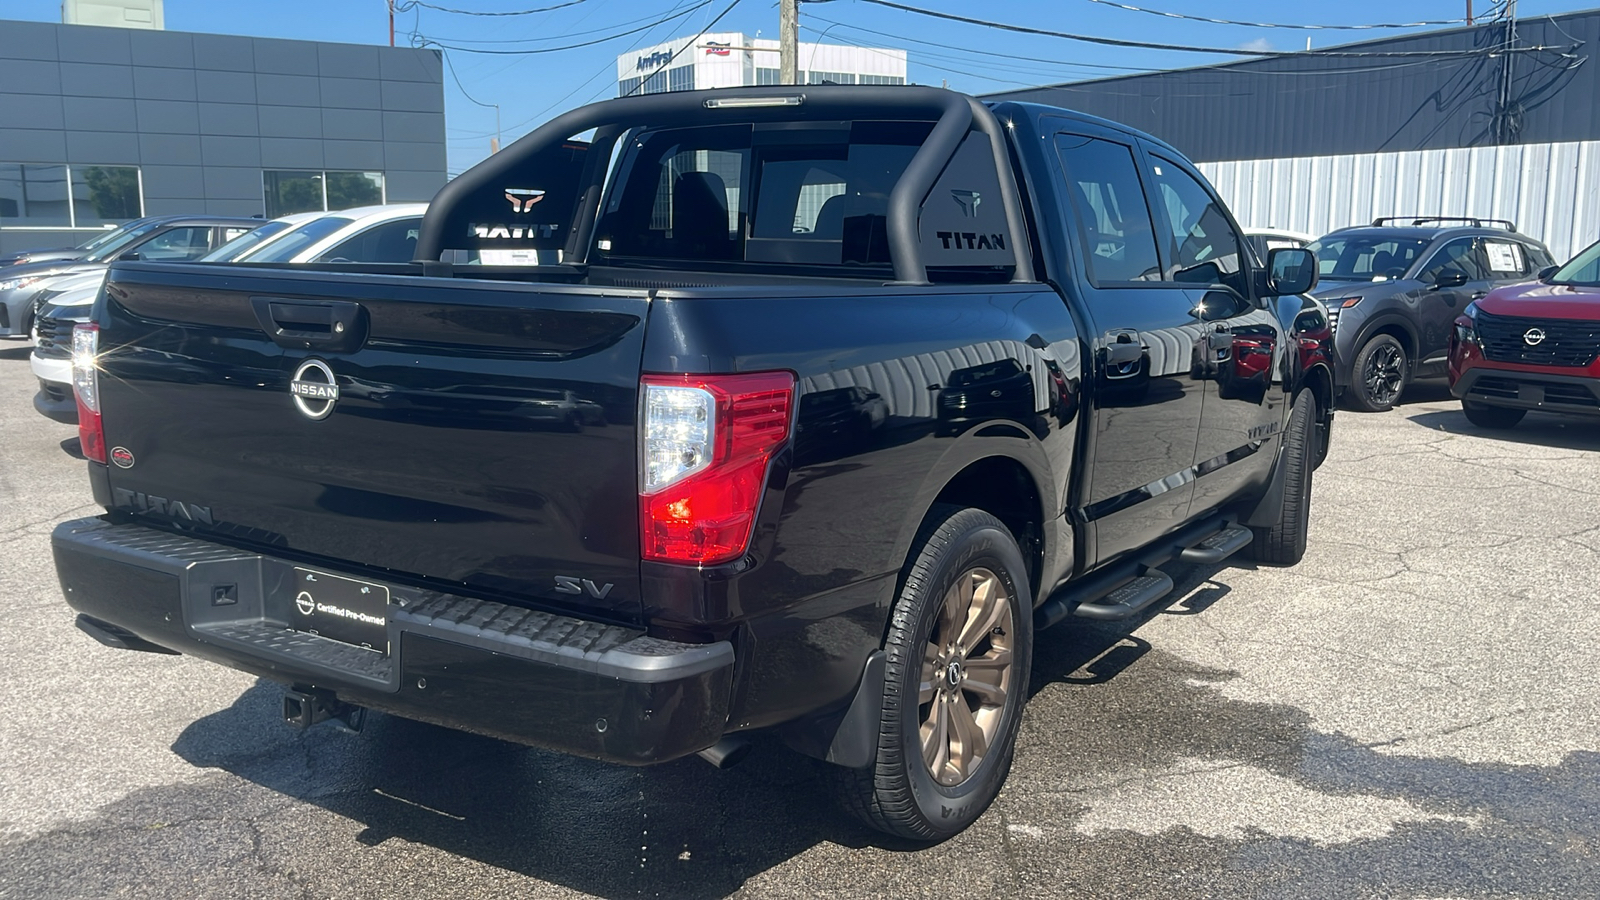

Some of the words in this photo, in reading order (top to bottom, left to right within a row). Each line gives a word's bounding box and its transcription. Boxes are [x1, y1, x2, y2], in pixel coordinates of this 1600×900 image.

[636, 48, 673, 72] AmFirst
[936, 231, 1006, 251] TITAN
[291, 382, 337, 398] NISSAN
[115, 486, 214, 526] TITAN
[554, 575, 614, 600] SV
[317, 602, 345, 617] Certified
[345, 609, 385, 626] Pre-Owned
